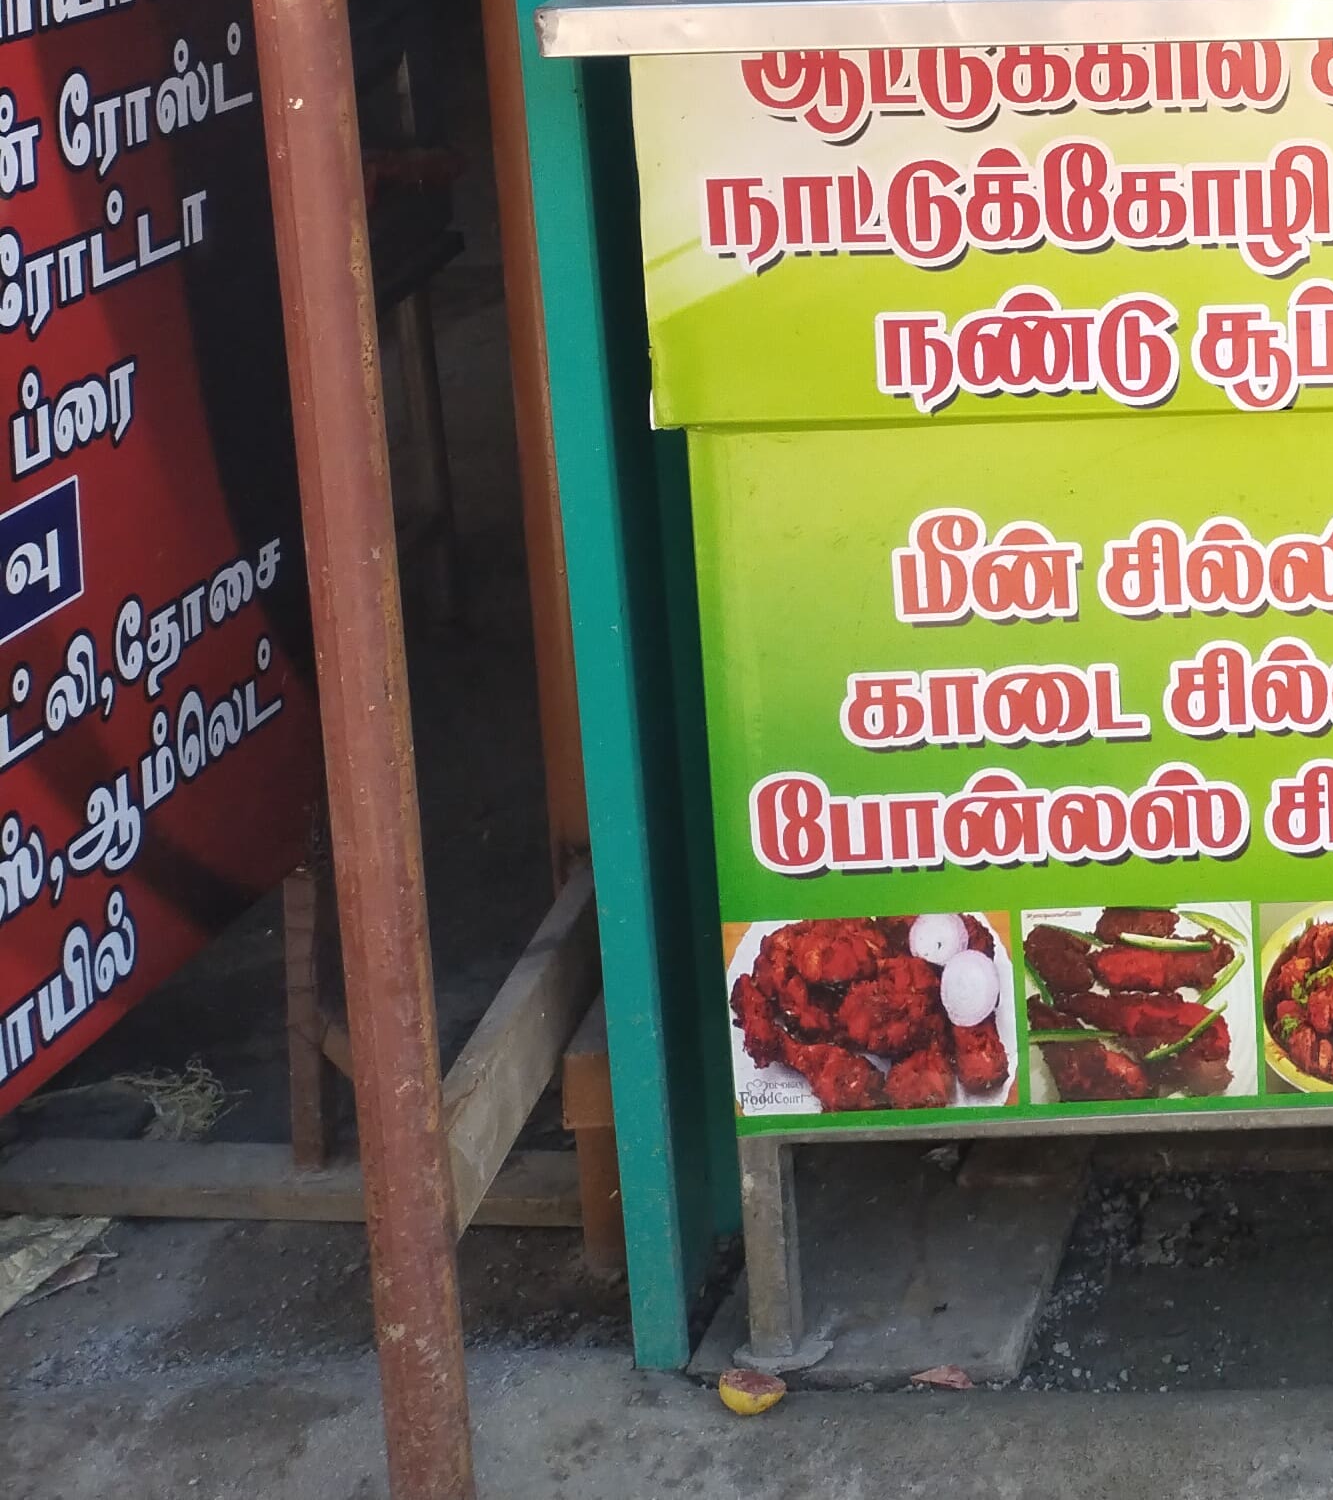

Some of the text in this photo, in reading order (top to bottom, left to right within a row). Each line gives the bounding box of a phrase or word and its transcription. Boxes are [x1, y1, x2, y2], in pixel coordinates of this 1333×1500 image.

[706, 142, 1331, 267] நாட்டுக்கோழி
[883, 292, 1173, 401] நண்டு
[900, 515, 1075, 616] மீன்
[847, 671, 1143, 741] காடை
[757, 769, 1243, 868] போன்லஸ்
